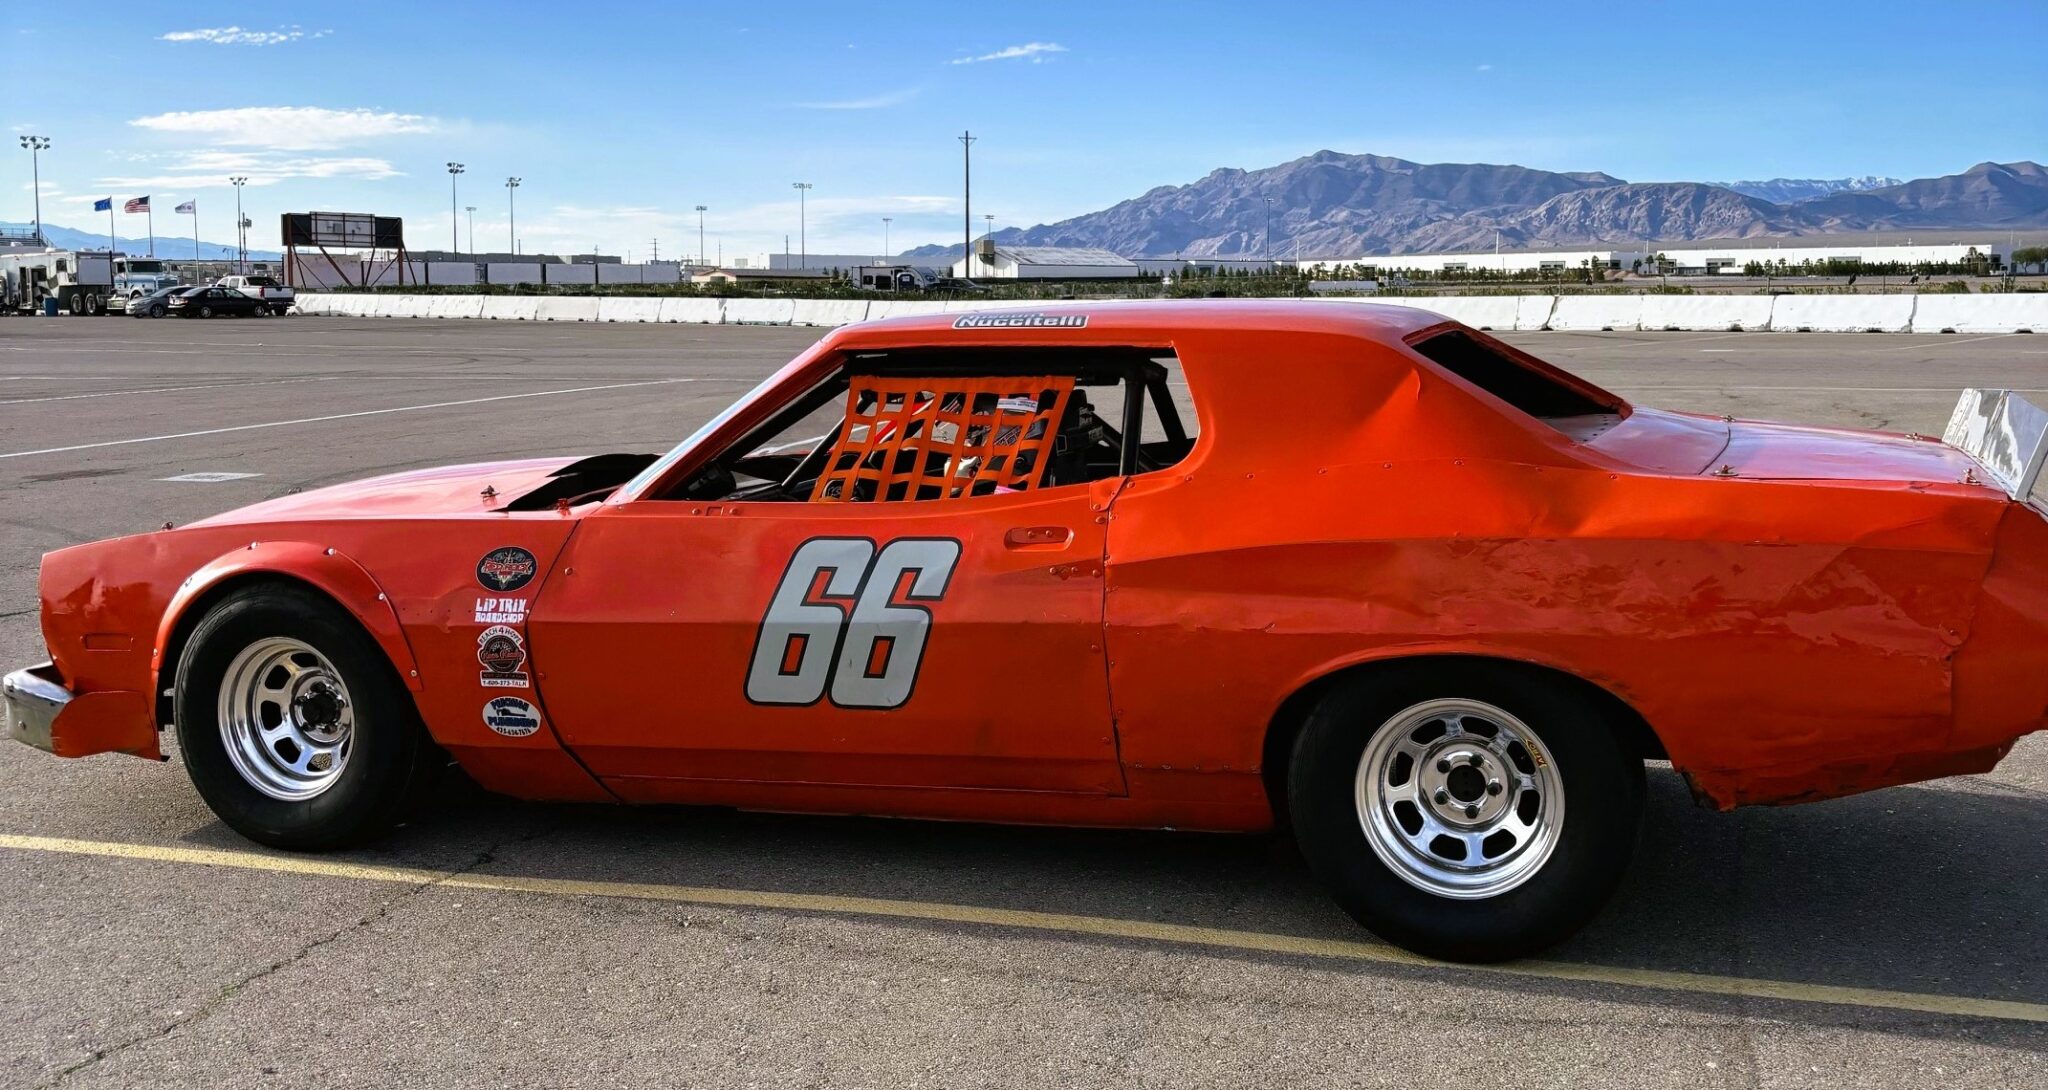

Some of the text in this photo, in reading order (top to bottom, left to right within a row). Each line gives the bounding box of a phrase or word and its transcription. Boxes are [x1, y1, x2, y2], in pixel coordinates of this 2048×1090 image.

[958, 316, 1082, 327] Nuccitelli
[474, 612, 524, 624] BOARDSHOP
[744, 536, 963, 710] 66
[498, 626, 504, 634] 4
